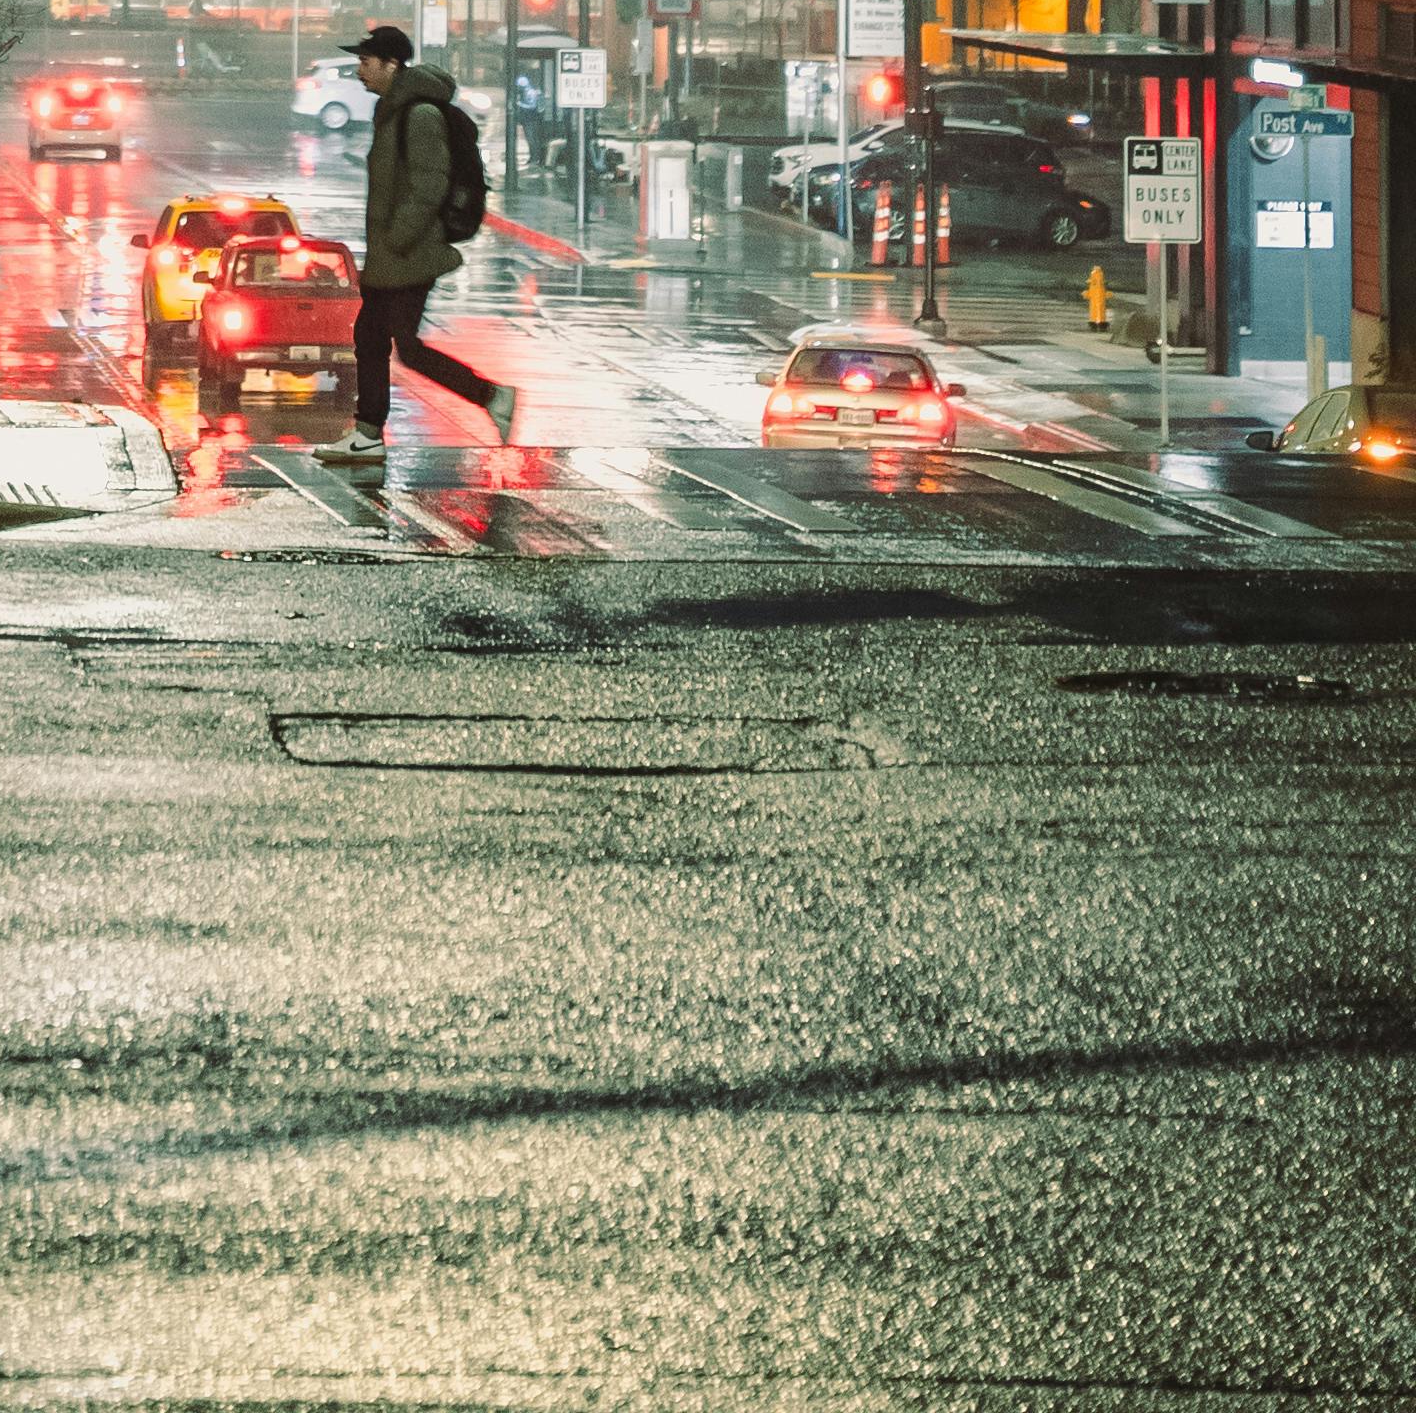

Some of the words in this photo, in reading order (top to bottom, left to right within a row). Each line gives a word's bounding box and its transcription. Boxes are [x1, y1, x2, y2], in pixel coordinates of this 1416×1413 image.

[564, 77, 601, 89] BUSES
[569, 90, 596, 101] ONLY
[1263, 114, 1296, 133] Post
[1302, 120, 1325, 134] Ave
[1165, 145, 1196, 157] CENTER
[1167, 159, 1193, 172] LANE
[1135, 187, 1191, 202] BUSES
[1142, 209, 1186, 224] ONLY
